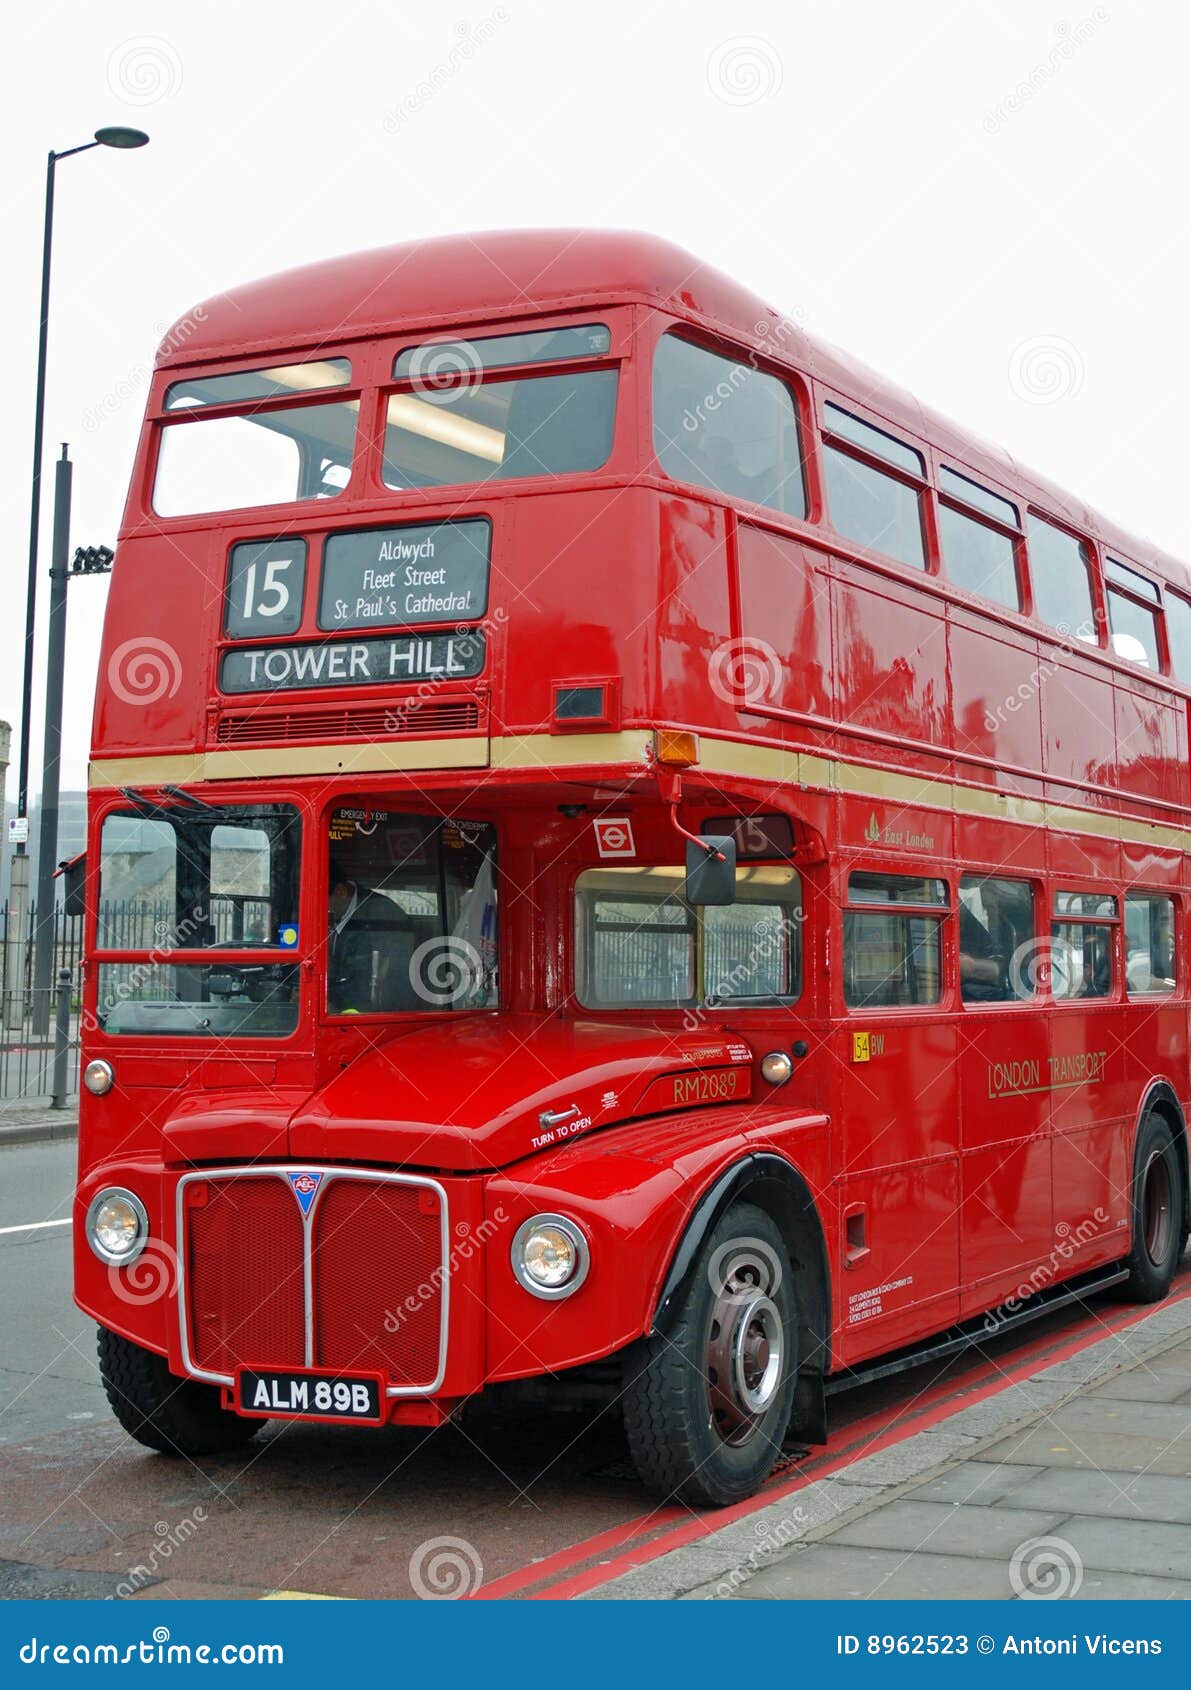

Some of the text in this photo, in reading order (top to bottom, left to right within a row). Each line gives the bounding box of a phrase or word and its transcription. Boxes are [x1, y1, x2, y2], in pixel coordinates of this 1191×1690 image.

[378, 538, 435, 564] Aldwych
[243, 559, 293, 618] 15
[362, 566, 446, 590] Fleet Street
[334, 591, 471, 620] St Paul's Cathedral
[244, 639, 465, 682] TOWER HILL
[735, 817, 768, 853] 15
[884, 826, 934, 849] East London
[855, 1035, 884, 1060] 54 BW
[674, 1071, 737, 1103] RM2089
[988, 1052, 1107, 1099] LONDON TRANSPORT
[531, 1116, 591, 1148] TURN TO OPEN
[295, 1180, 315, 1189] AEC
[253, 1379, 370, 1413] ALM 89B
